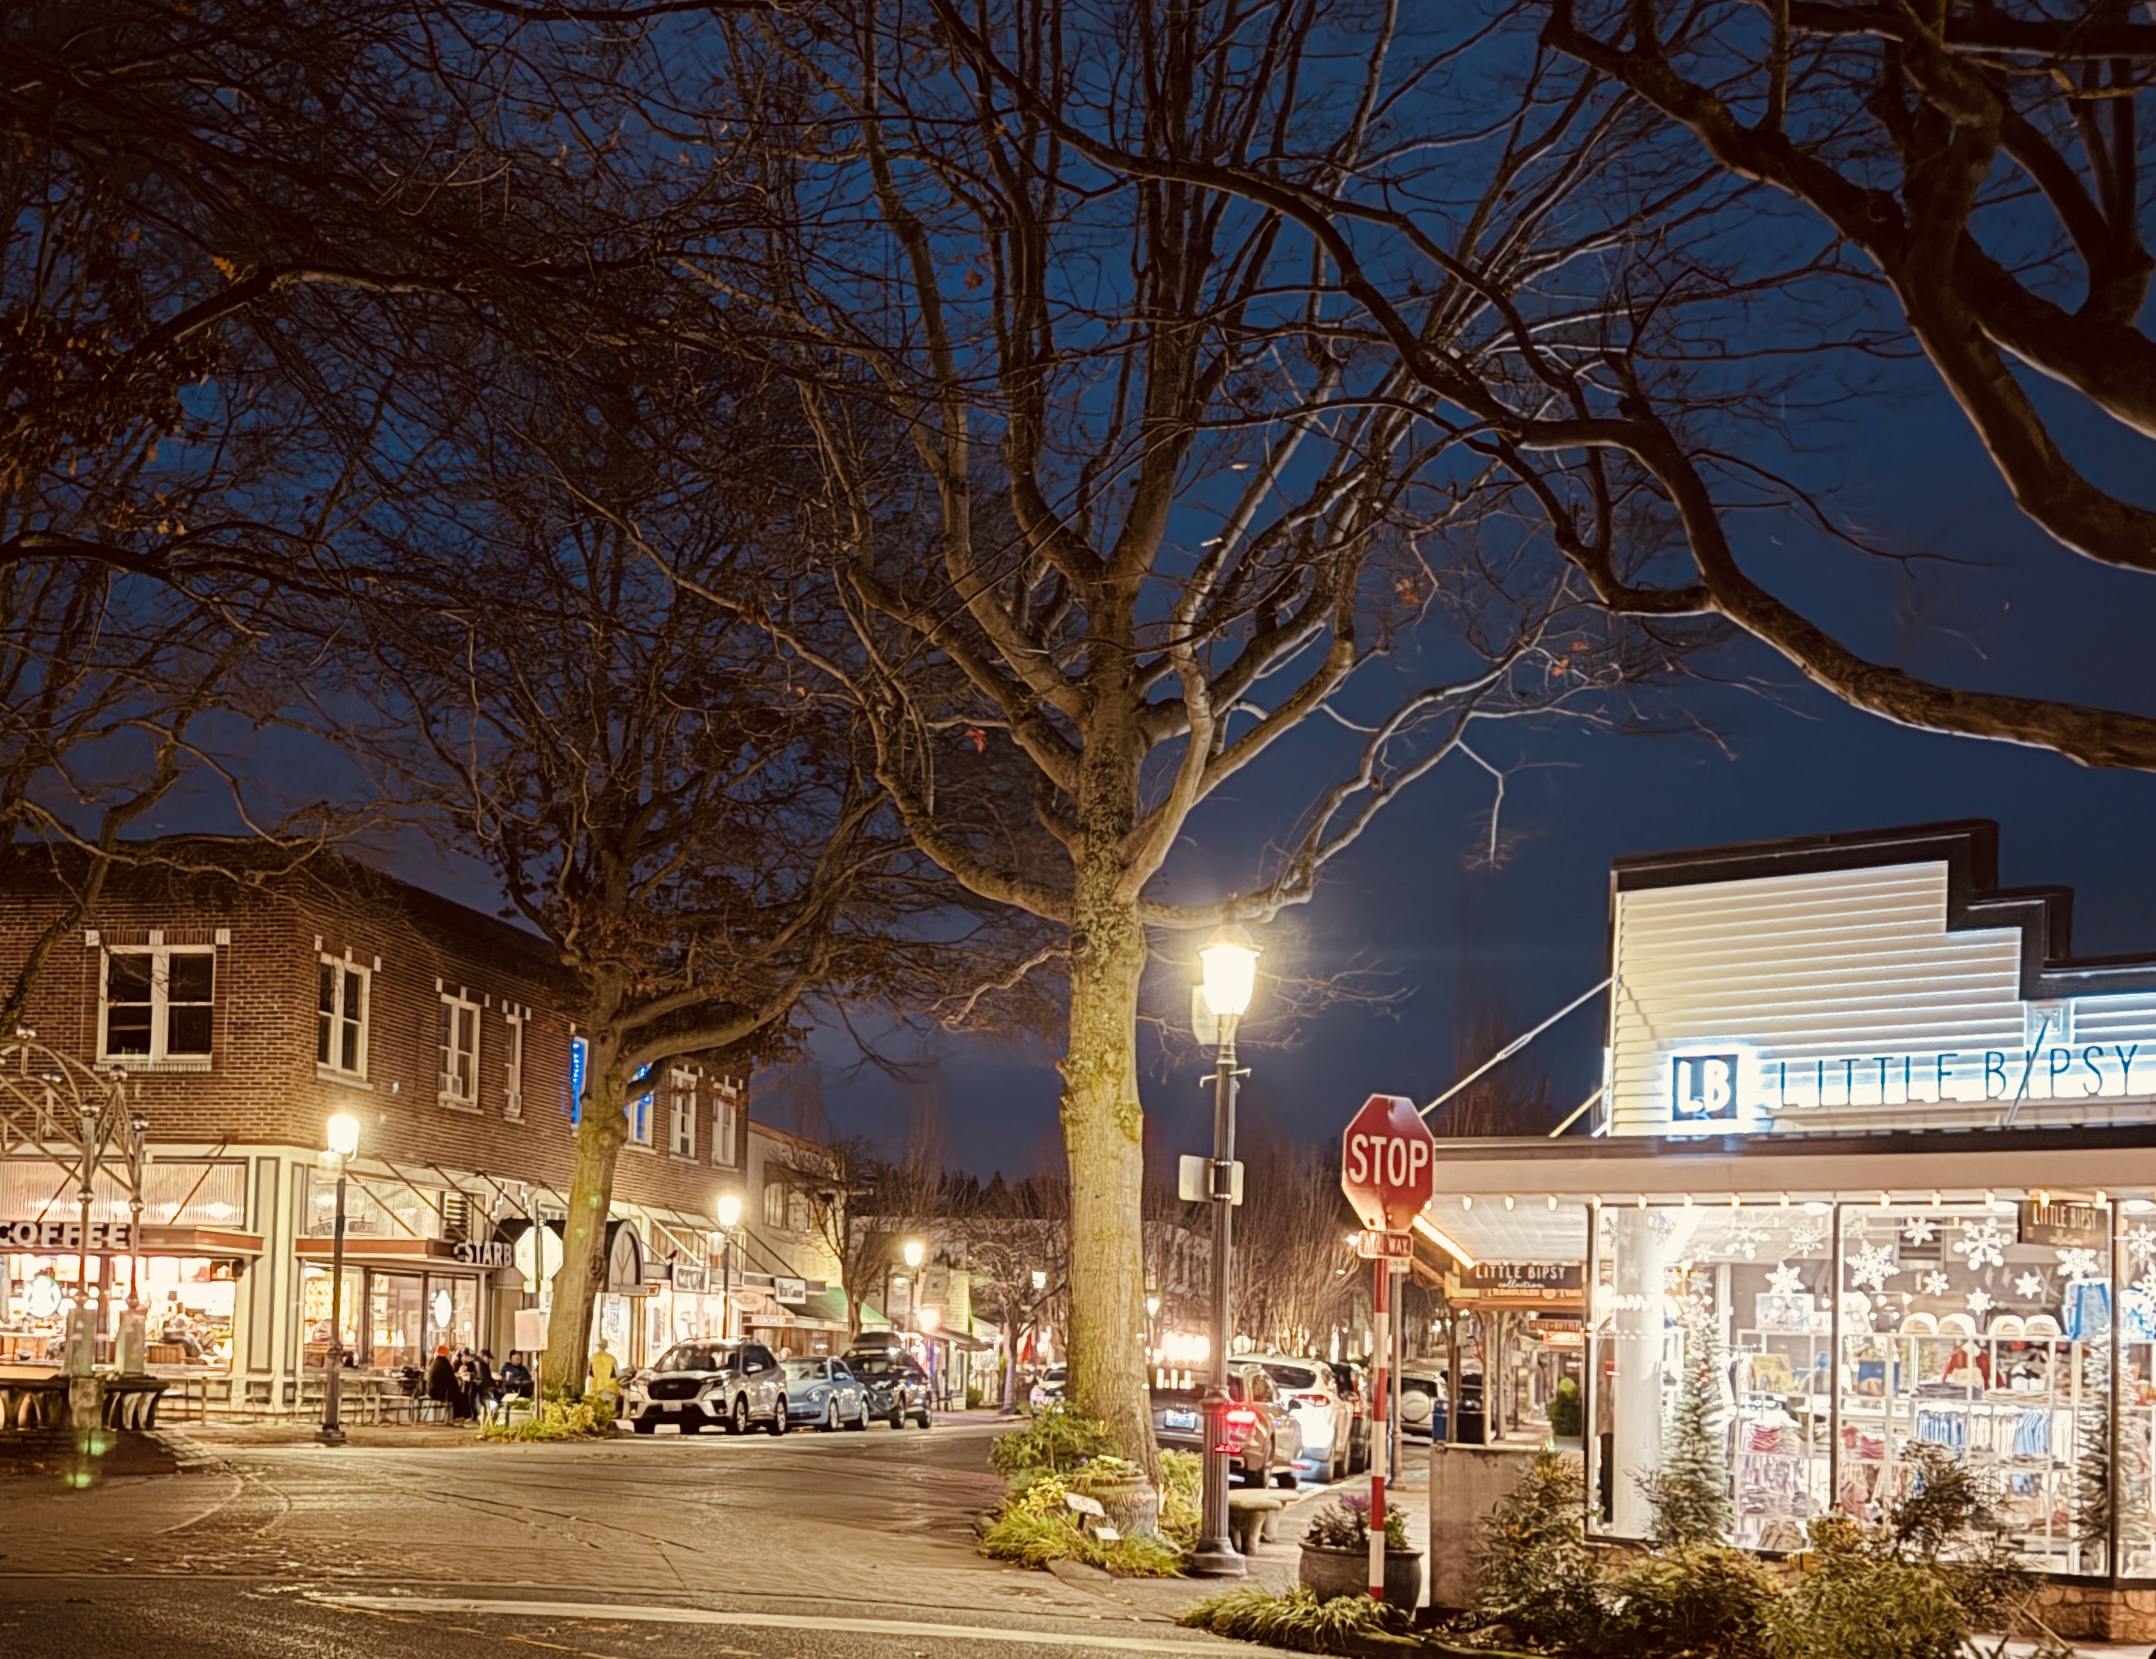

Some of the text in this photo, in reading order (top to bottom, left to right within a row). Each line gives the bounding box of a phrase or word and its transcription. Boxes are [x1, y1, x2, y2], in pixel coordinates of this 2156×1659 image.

[1677, 1059, 1731, 1113] LB
[1780, 1044, 2138, 1106] LITTLE BIPSY
[1348, 1133, 1429, 1188] STOP
[2033, 1203, 2097, 1231] LITTLE BIPSY
[1388, 1238, 1409, 1254] WAY
[1475, 1264, 1566, 1280] LITTLE BIPSY
[1498, 1279, 1545, 1289] collection
